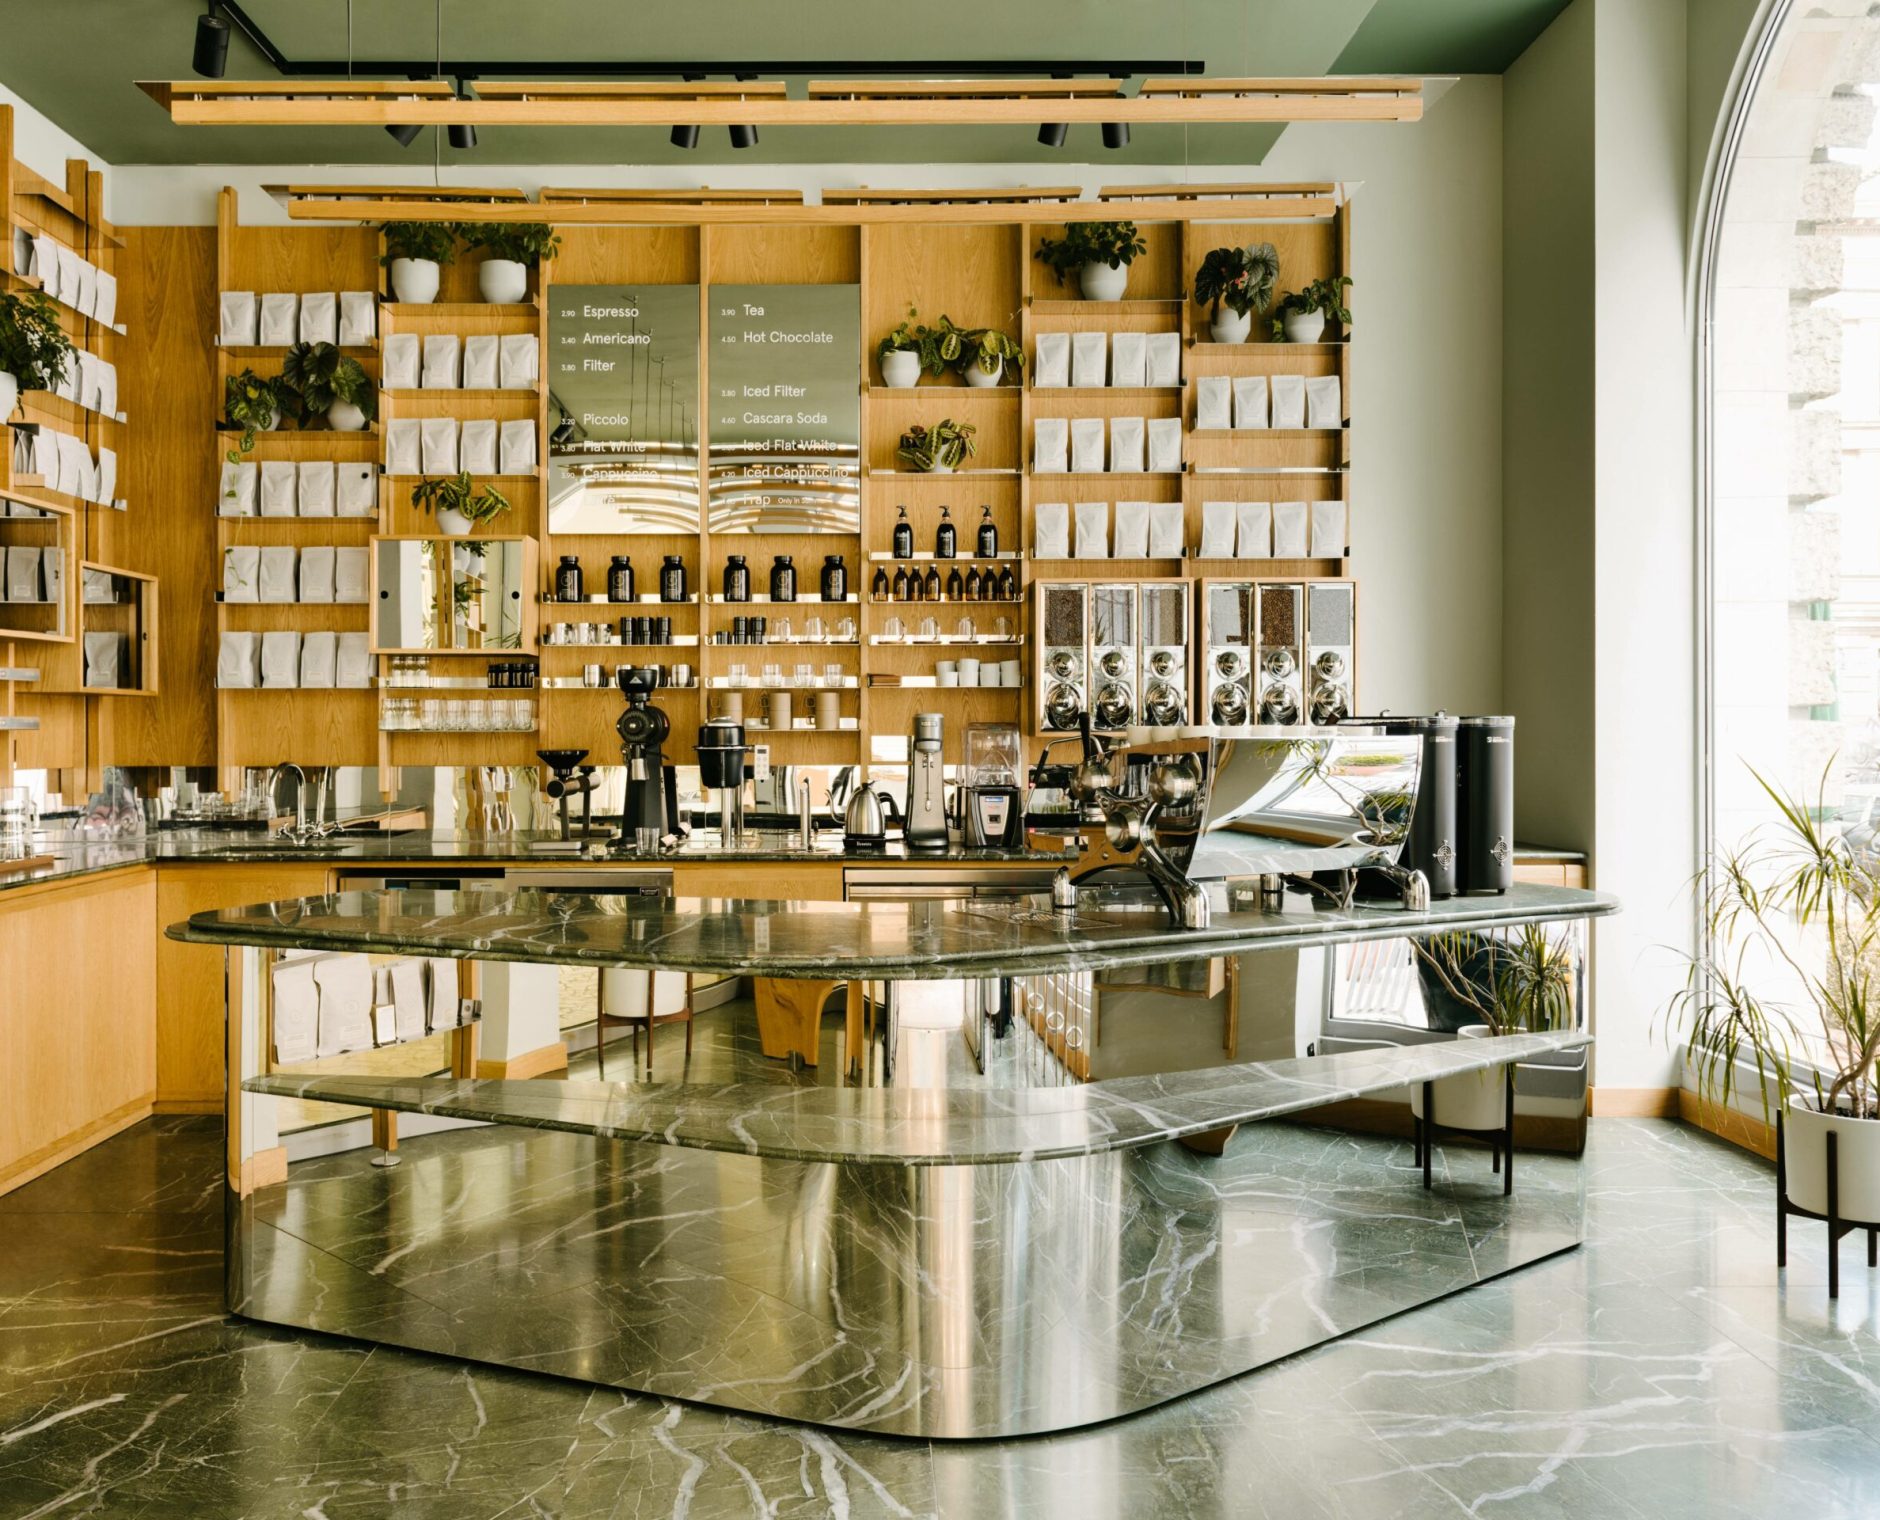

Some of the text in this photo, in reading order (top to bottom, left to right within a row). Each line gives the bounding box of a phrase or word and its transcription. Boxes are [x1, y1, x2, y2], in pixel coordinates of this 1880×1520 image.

[583, 305, 639, 320] Espresso
[743, 304, 765, 316] Tea
[583, 333, 651, 345] Americano
[743, 331, 767, 343] Hot
[769, 331, 834, 343] Chocolate
[583, 359, 616, 371] Filter
[743, 385, 770, 397] Iced
[774, 385, 807, 397] Filter
[583, 413, 629, 425] Piccolo
[743, 412, 793, 424] Cascara
[797, 412, 828, 424] Soda
[583, 440, 607, 453] Flat
[610, 439, 647, 453] White
[743, 439, 770, 451] Iced
[774, 439, 798, 451] Flat
[800, 439, 838, 451] White
[583, 467, 659, 481] Cappuccino
[743, 466, 770, 478] Iced
[773, 466, 849, 481] Cappuccino
[743, 493, 771, 510] Frap
[777, 497, 793, 505] Only
